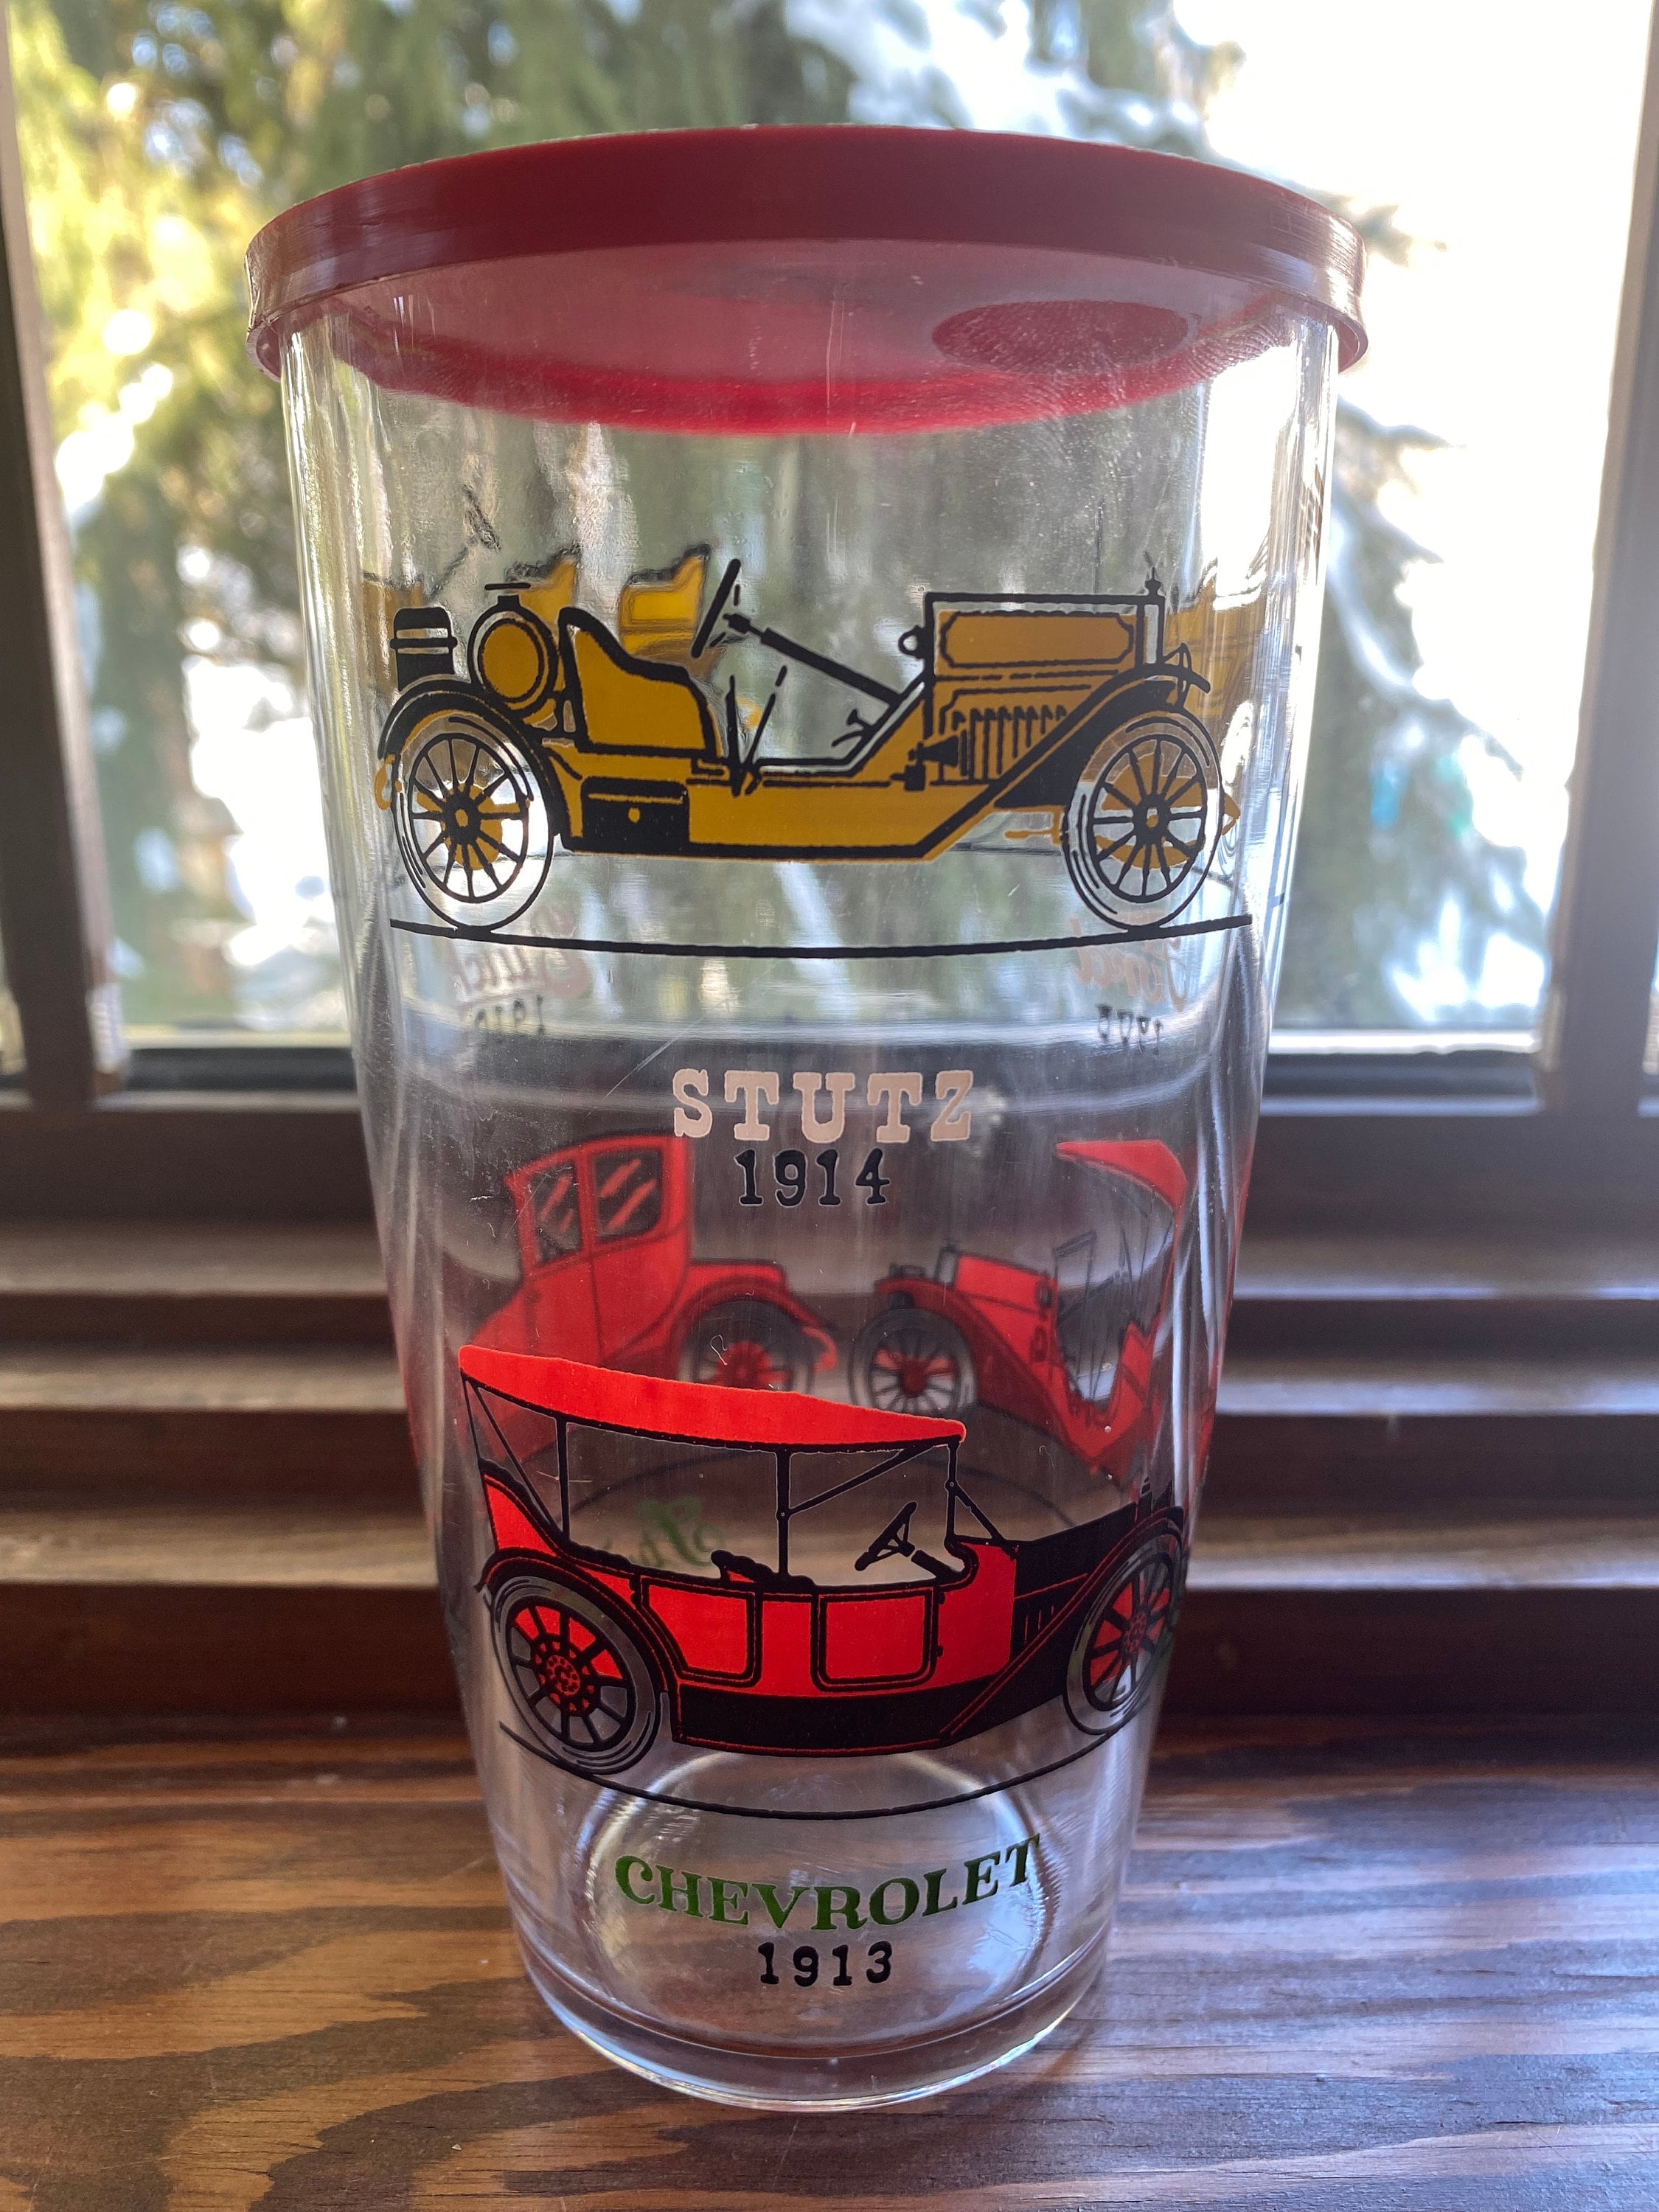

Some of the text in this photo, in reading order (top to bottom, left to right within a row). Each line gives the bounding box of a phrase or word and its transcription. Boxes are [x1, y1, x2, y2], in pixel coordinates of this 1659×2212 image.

[672, 1068, 973, 1144] STUTZ
[734, 1147, 890, 1207] 1914
[615, 1833, 1041, 1930] CHEVROLET
[757, 1941, 892, 1987] 1913
